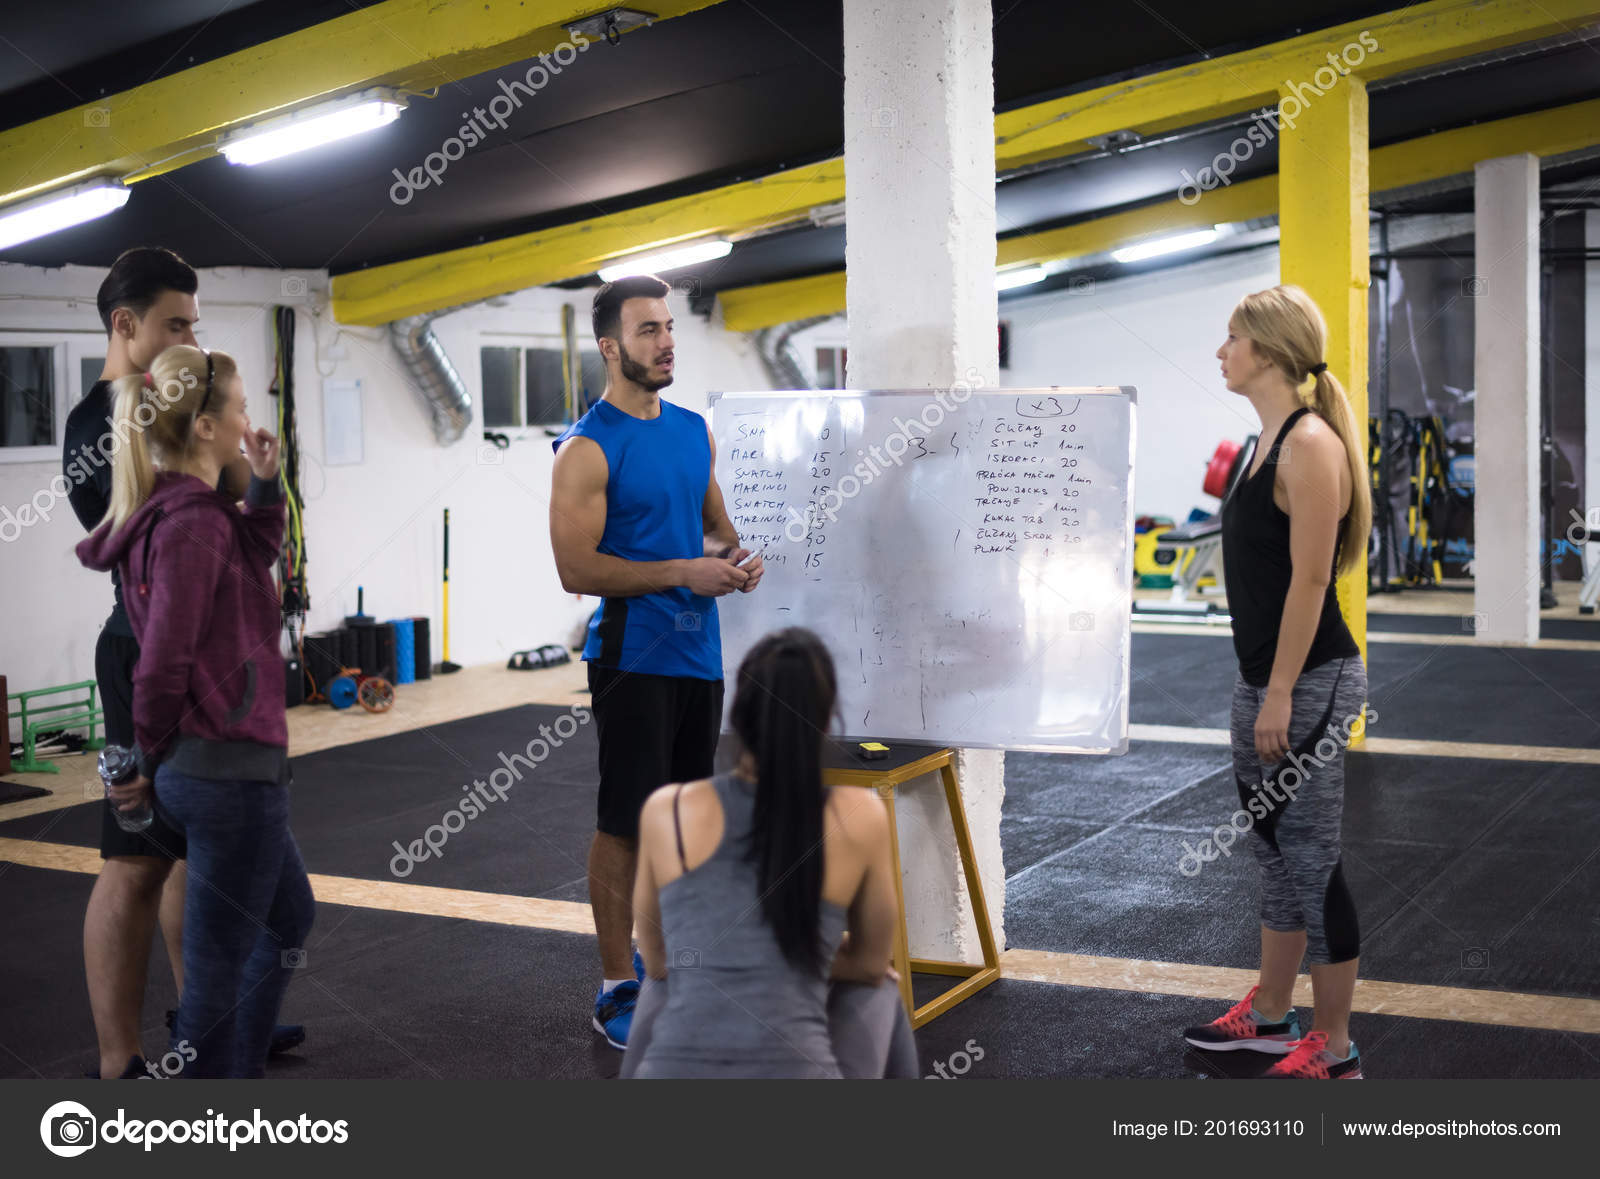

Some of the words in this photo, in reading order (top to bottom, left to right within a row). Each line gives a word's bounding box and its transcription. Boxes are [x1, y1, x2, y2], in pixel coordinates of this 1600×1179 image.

[1061, 424, 1076, 432] 20
[991, 439, 1016, 448] SIT
[812, 452, 831, 463] 15
[1061, 457, 1078, 468] 20
[735, 467, 783, 479] SNATCH
[811, 467, 831, 478] 20
[733, 483, 787, 493] MARINCI
[812, 486, 830, 497] 15
[1063, 487, 1080, 497] 20
[735, 500, 785, 510] SNATCH
[1061, 517, 1080, 527] 20
[804, 552, 824, 568] 15
